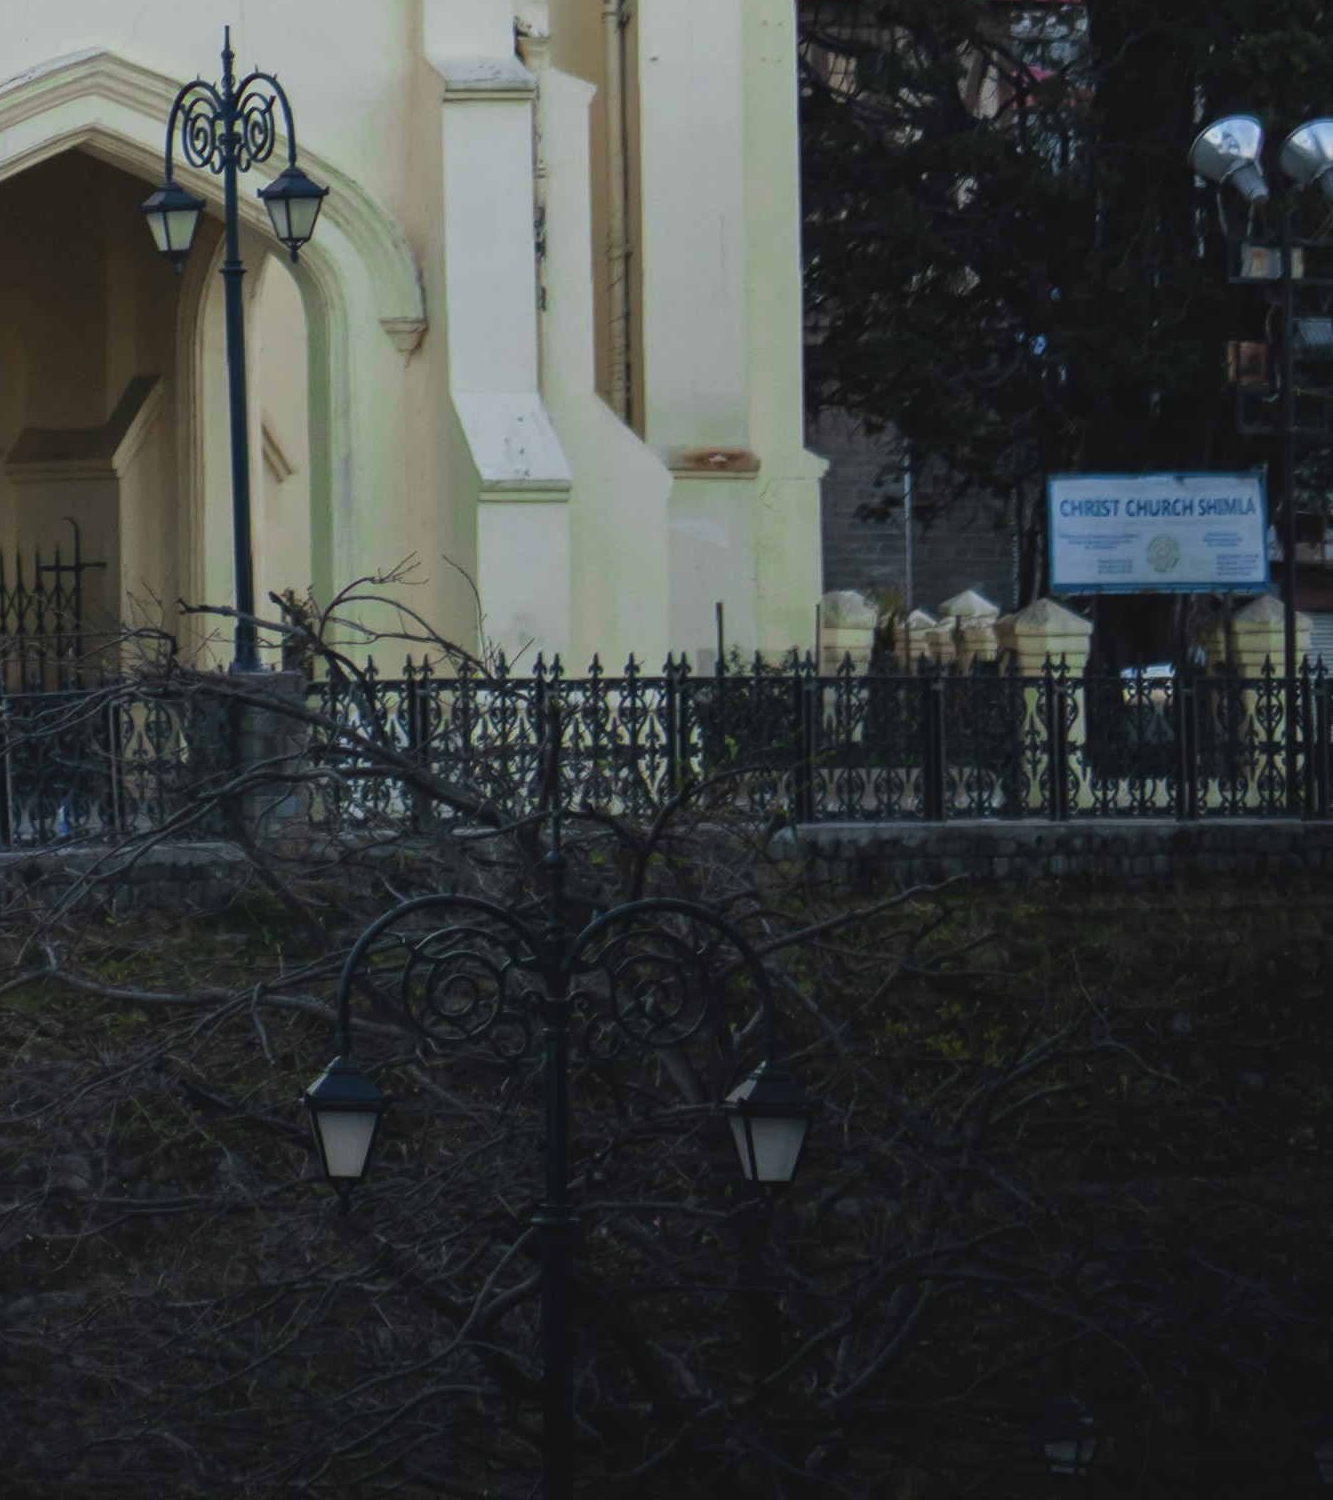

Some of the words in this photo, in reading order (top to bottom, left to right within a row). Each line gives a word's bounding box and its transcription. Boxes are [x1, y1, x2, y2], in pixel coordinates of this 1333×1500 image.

[1059, 499, 1119, 517] CHRIST
[1125, 498, 1193, 517] CHURCH
[1198, 497, 1256, 516] SHIMLA
